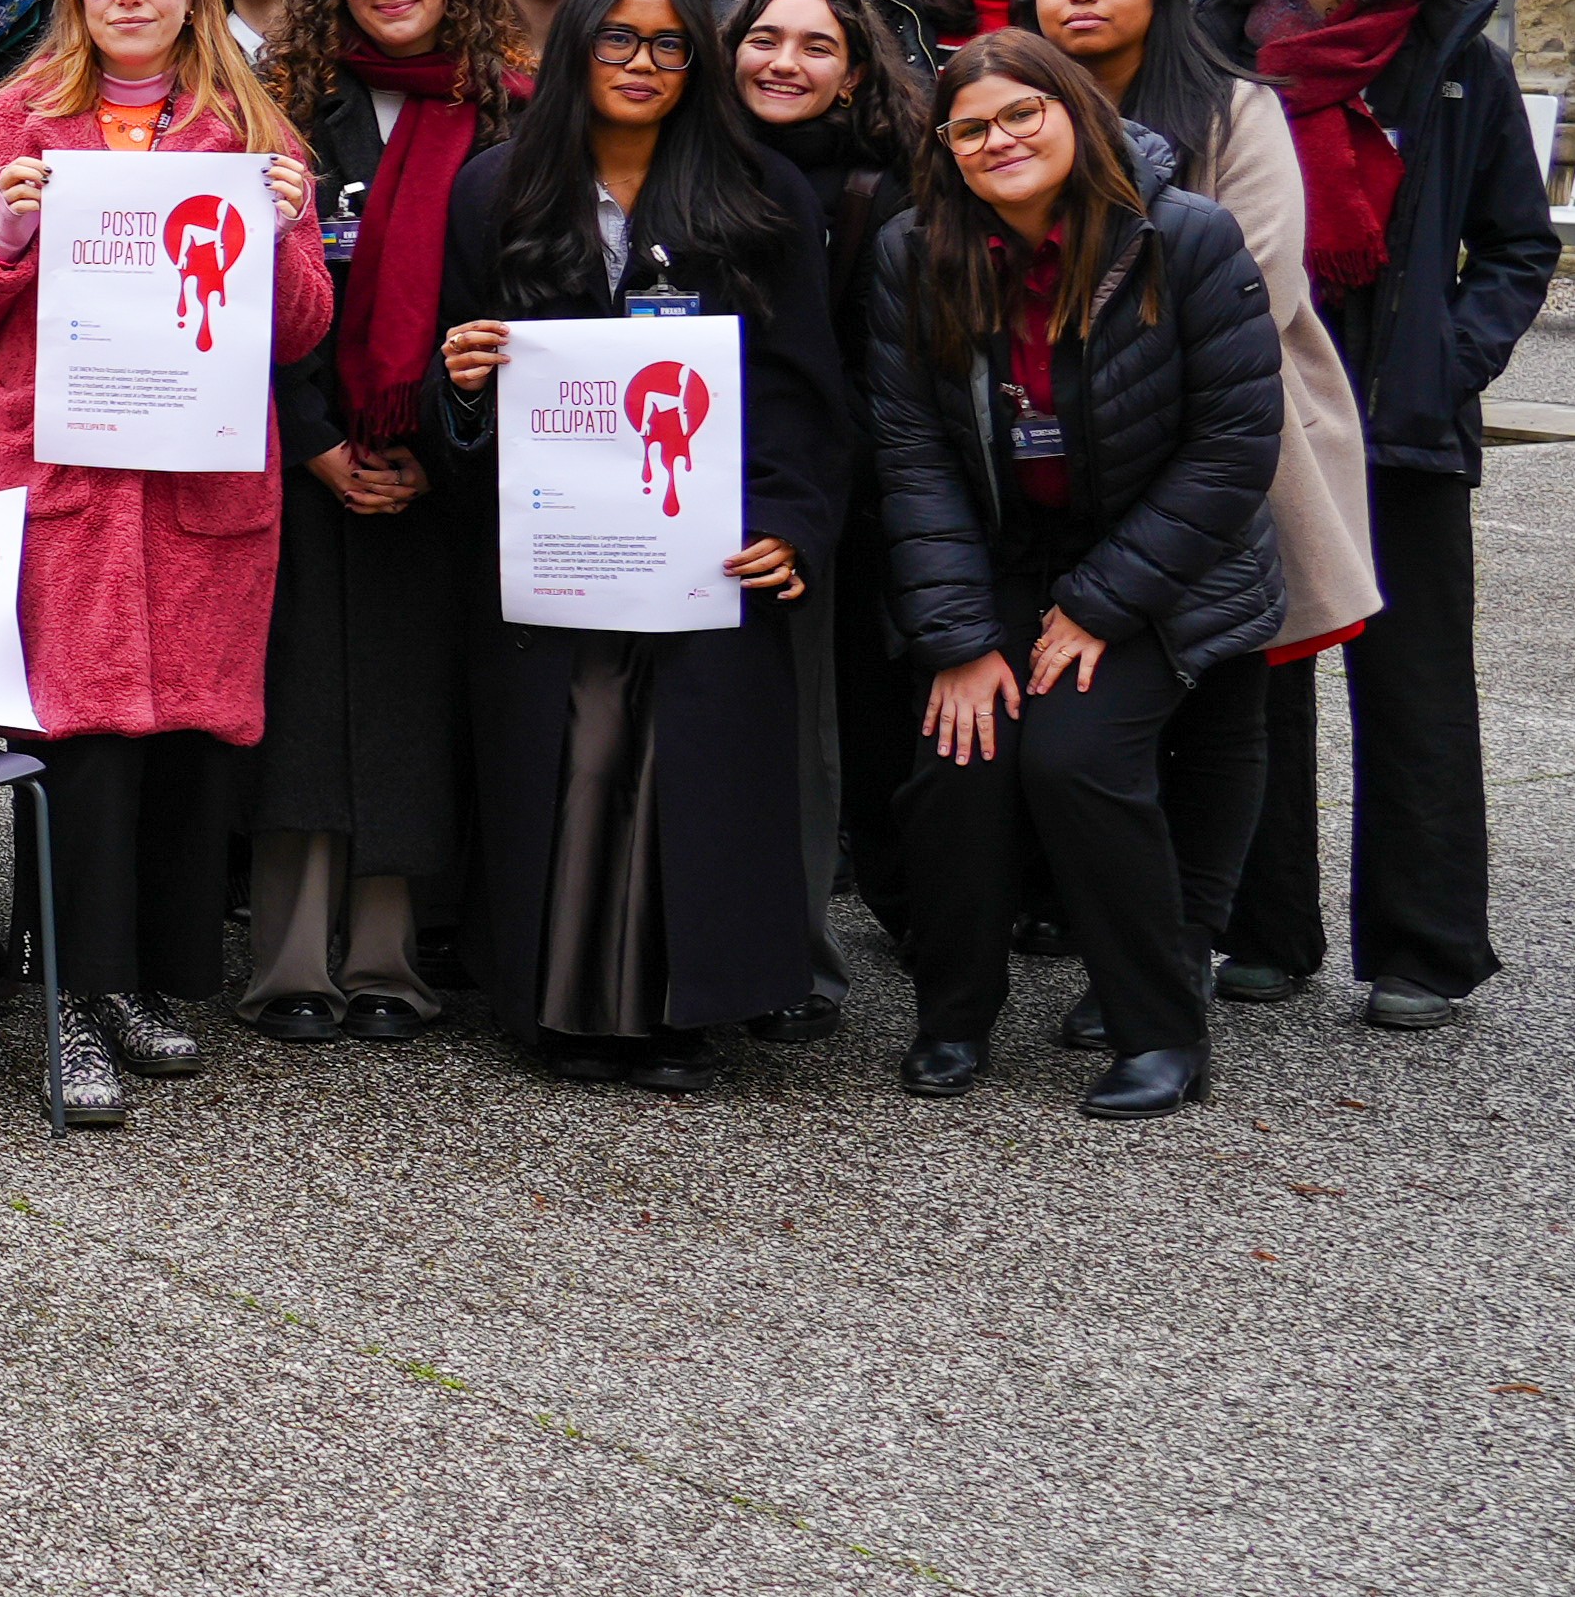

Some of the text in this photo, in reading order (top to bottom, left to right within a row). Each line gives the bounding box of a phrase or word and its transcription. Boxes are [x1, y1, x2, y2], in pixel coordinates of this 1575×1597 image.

[100, 210, 157, 236] POSTO
[71, 239, 156, 267] OCCUPATO
[559, 380, 617, 406] POSTO
[531, 408, 617, 435] OCCUPATO
